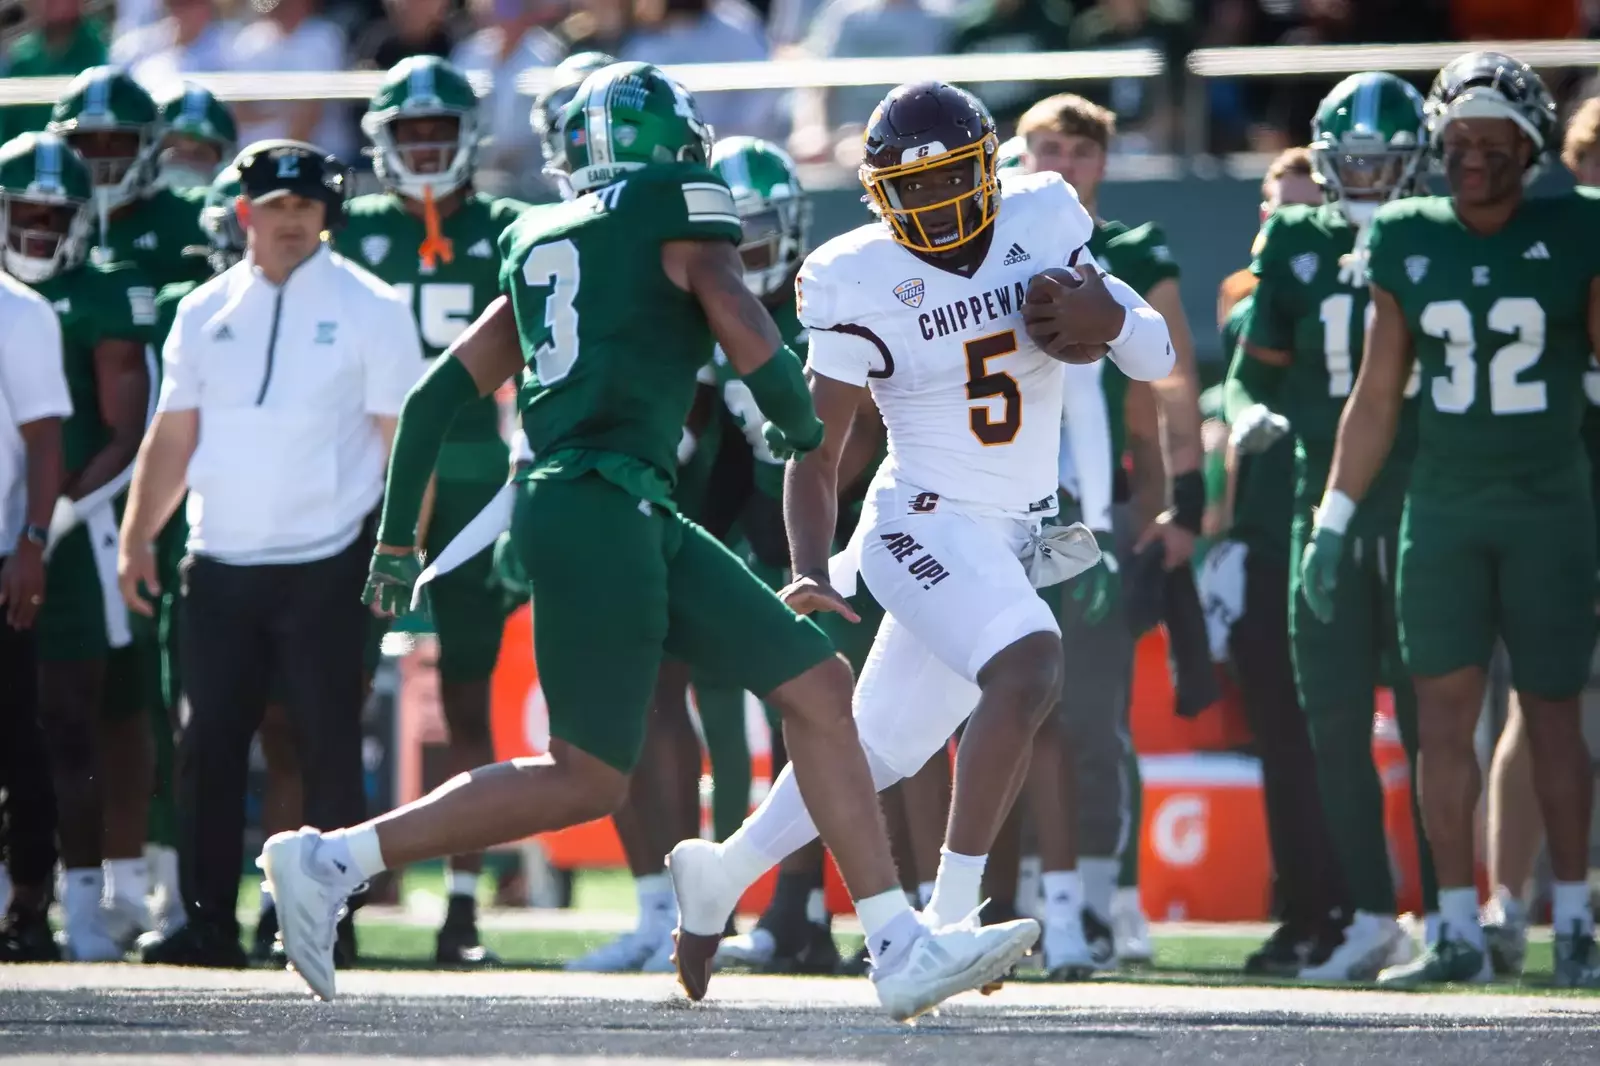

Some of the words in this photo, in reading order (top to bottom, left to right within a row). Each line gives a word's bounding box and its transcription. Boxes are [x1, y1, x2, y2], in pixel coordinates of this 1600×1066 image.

[898, 284, 925, 301] MAC
[1003, 252, 1031, 266] adidas
[522, 238, 580, 387] 3
[918, 279, 1034, 341] CHIPPEWA
[964, 328, 1022, 446] 5
[1420, 296, 1548, 416] 32
[908, 554, 950, 590] UP!
[1151, 794, 1209, 867] G
